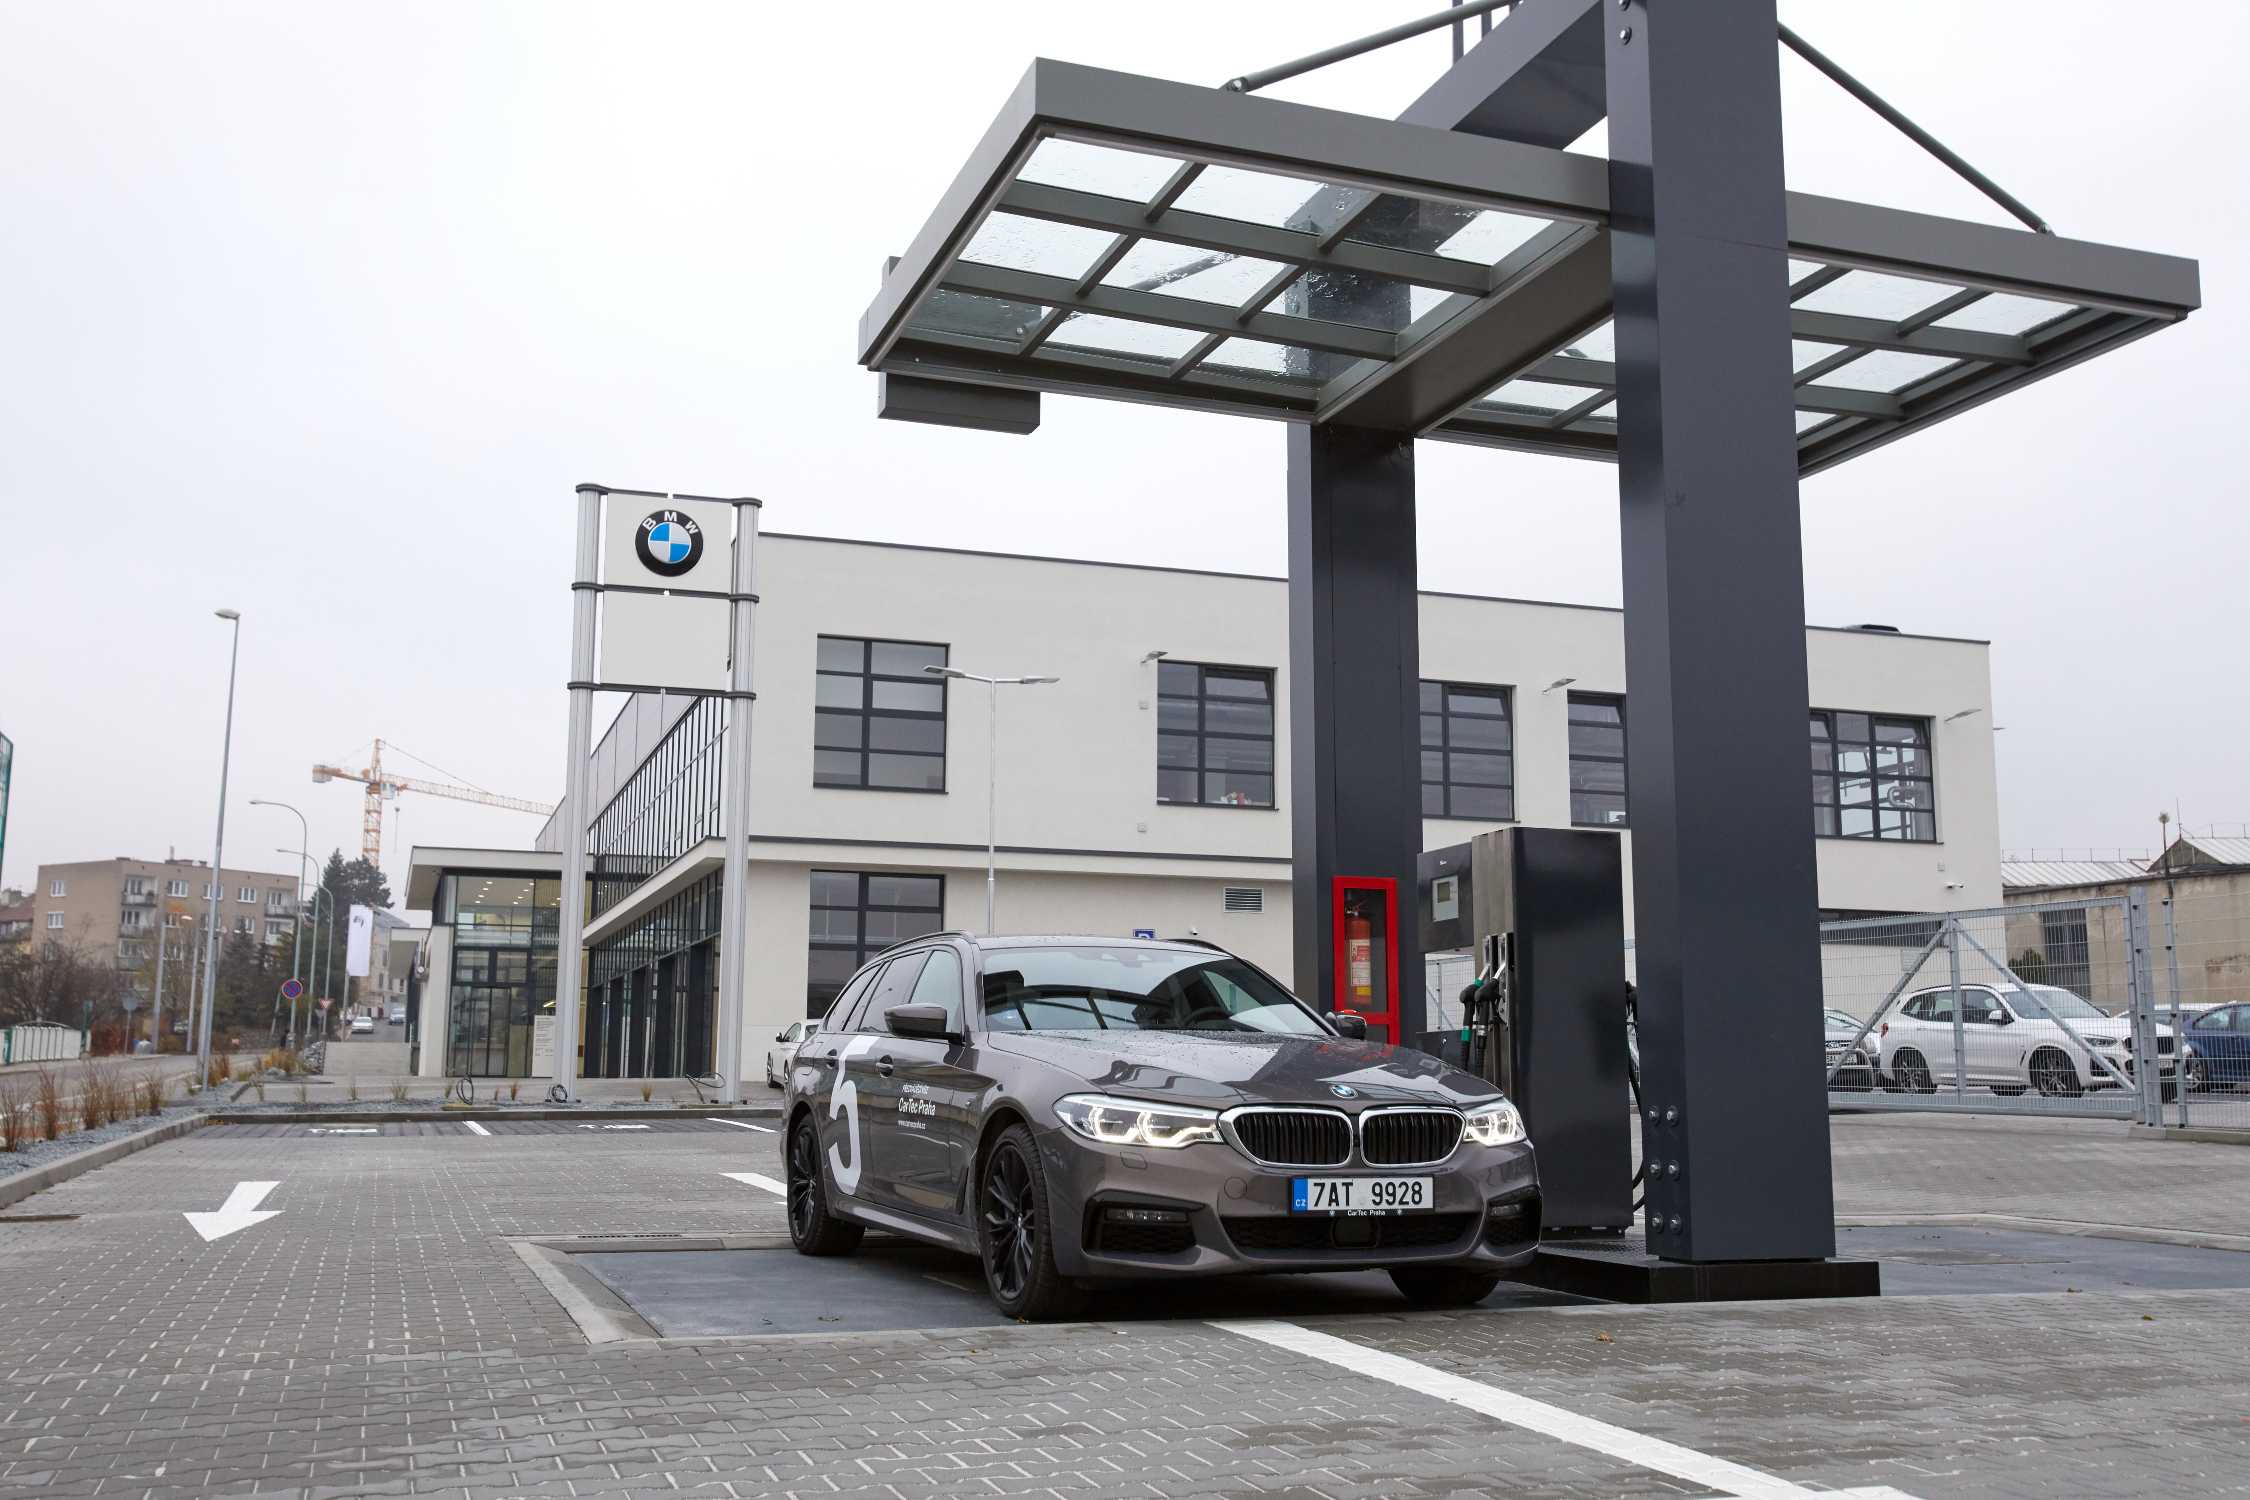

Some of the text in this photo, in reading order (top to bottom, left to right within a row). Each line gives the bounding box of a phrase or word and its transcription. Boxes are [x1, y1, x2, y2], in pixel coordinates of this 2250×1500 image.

[642, 511, 699, 535] BMW
[898, 1098, 936, 1116] CarTec Praha
[1295, 1199, 1306, 1207] CZ
[1313, 1181, 1423, 1207] 7AT 9928
